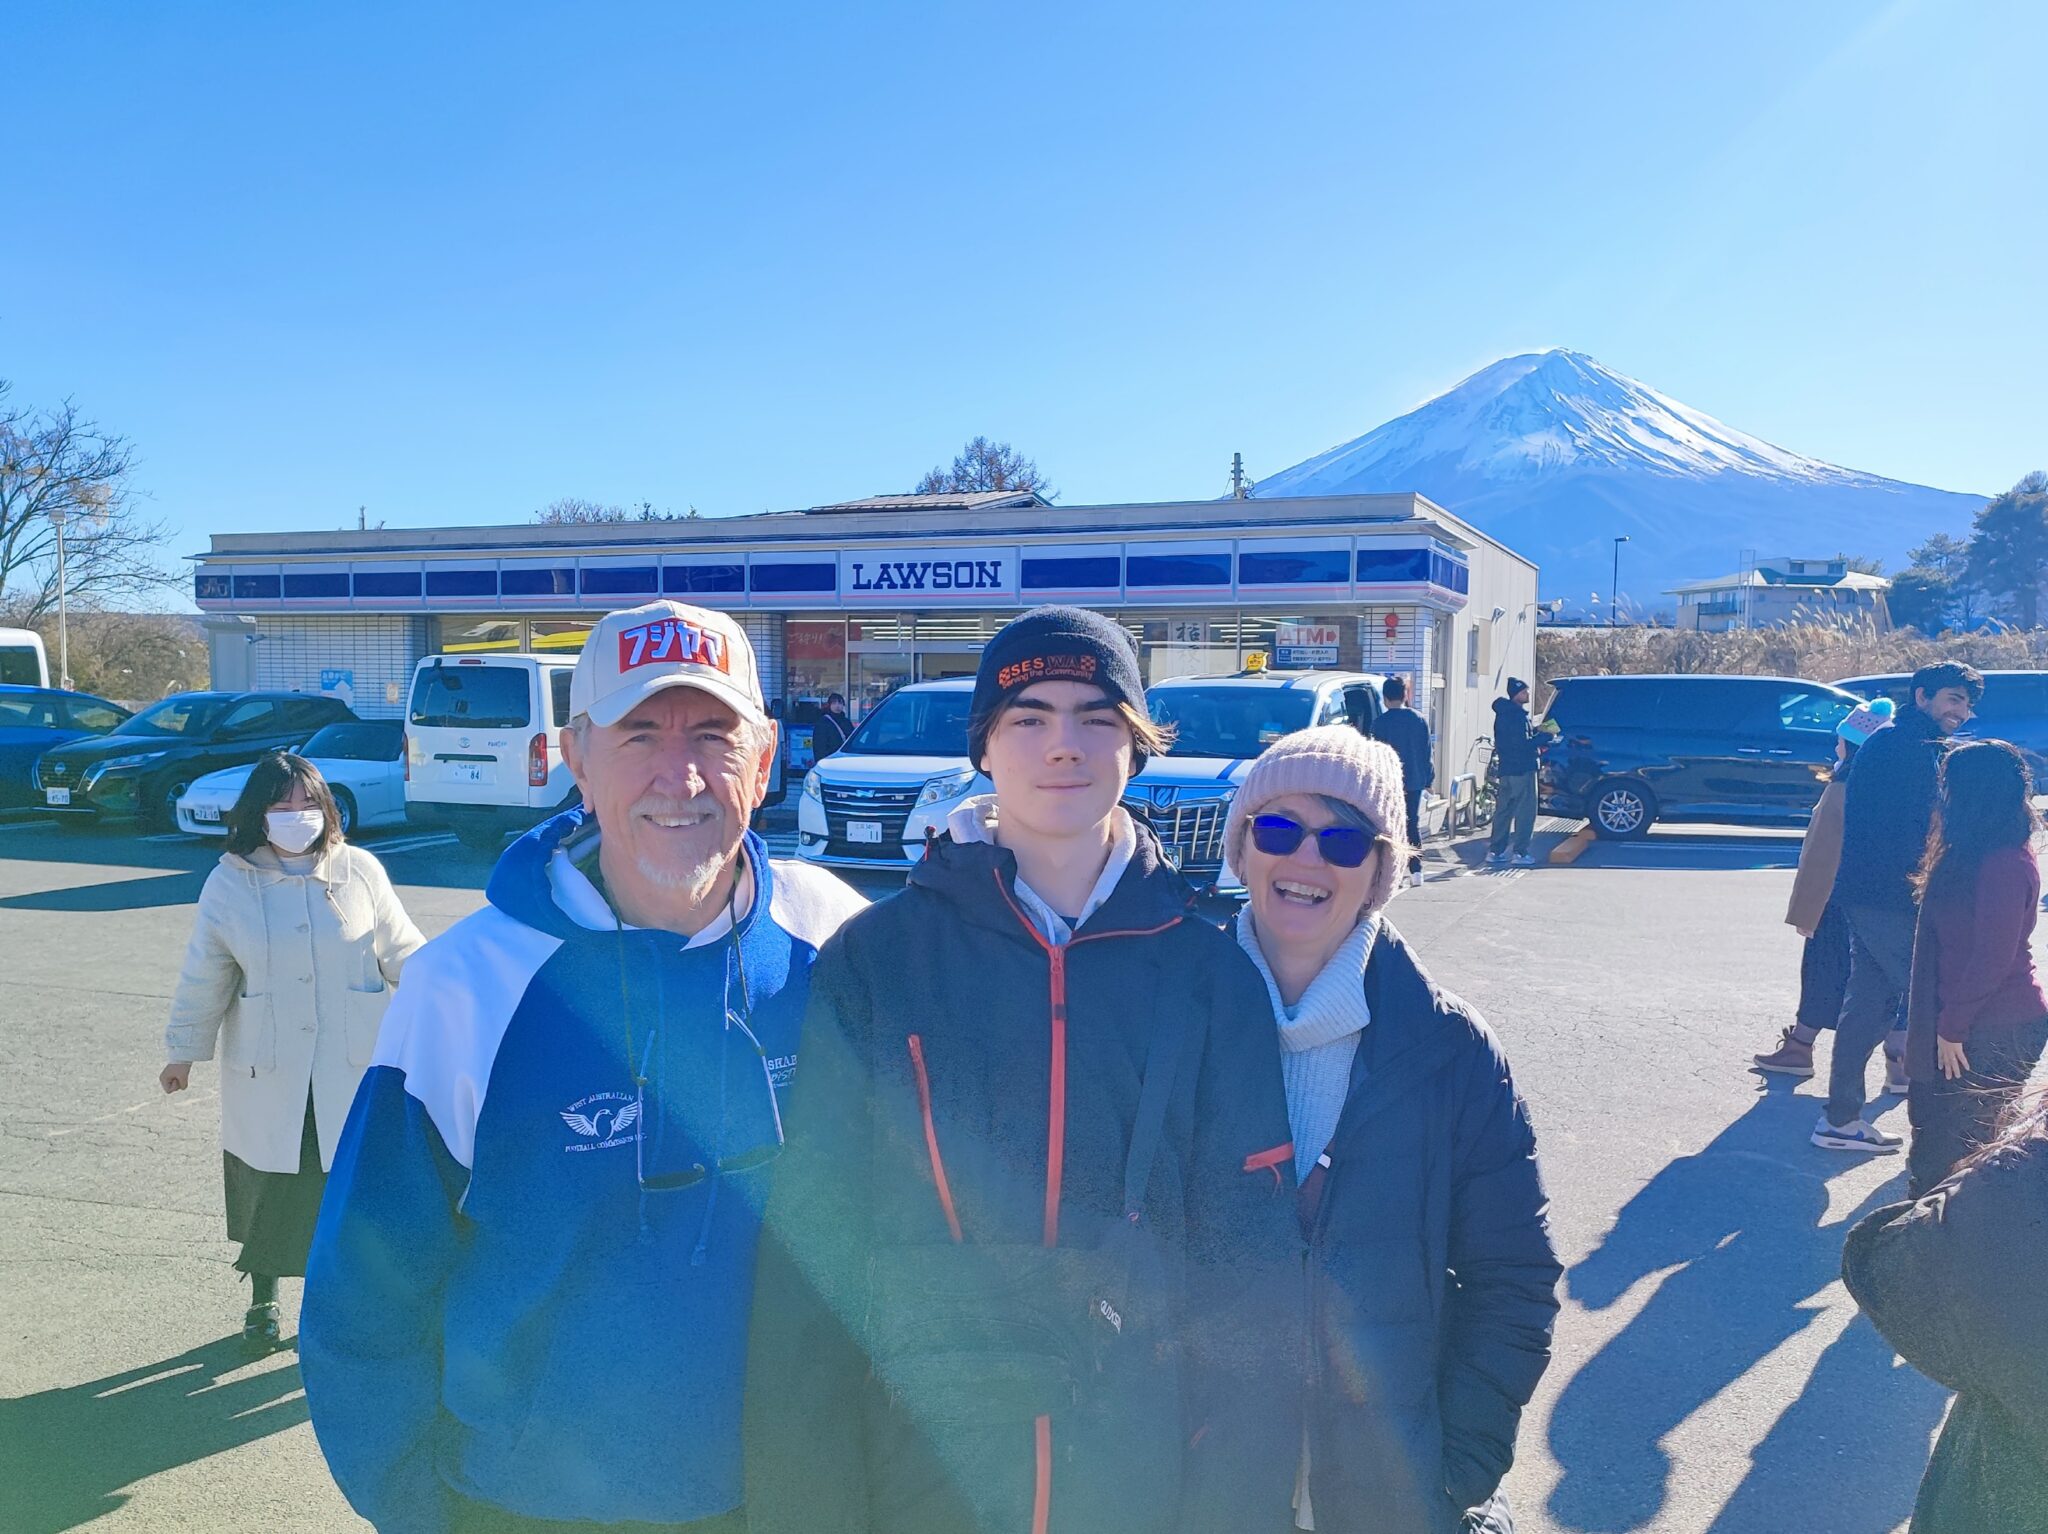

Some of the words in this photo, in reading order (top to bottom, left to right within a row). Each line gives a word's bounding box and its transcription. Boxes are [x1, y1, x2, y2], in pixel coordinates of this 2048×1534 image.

[852, 561, 1002, 590] LAWSON
[624, 621, 722, 667] フジヤマ
[1279, 627, 1325, 645] ATM
[1011, 657, 1044, 677] SES
[1029, 668, 1044, 678] the
[1044, 667, 1093, 681] Community
[567, 1098, 587, 1113] WEST
[588, 1091, 635, 1104] AUSTRALIAN
